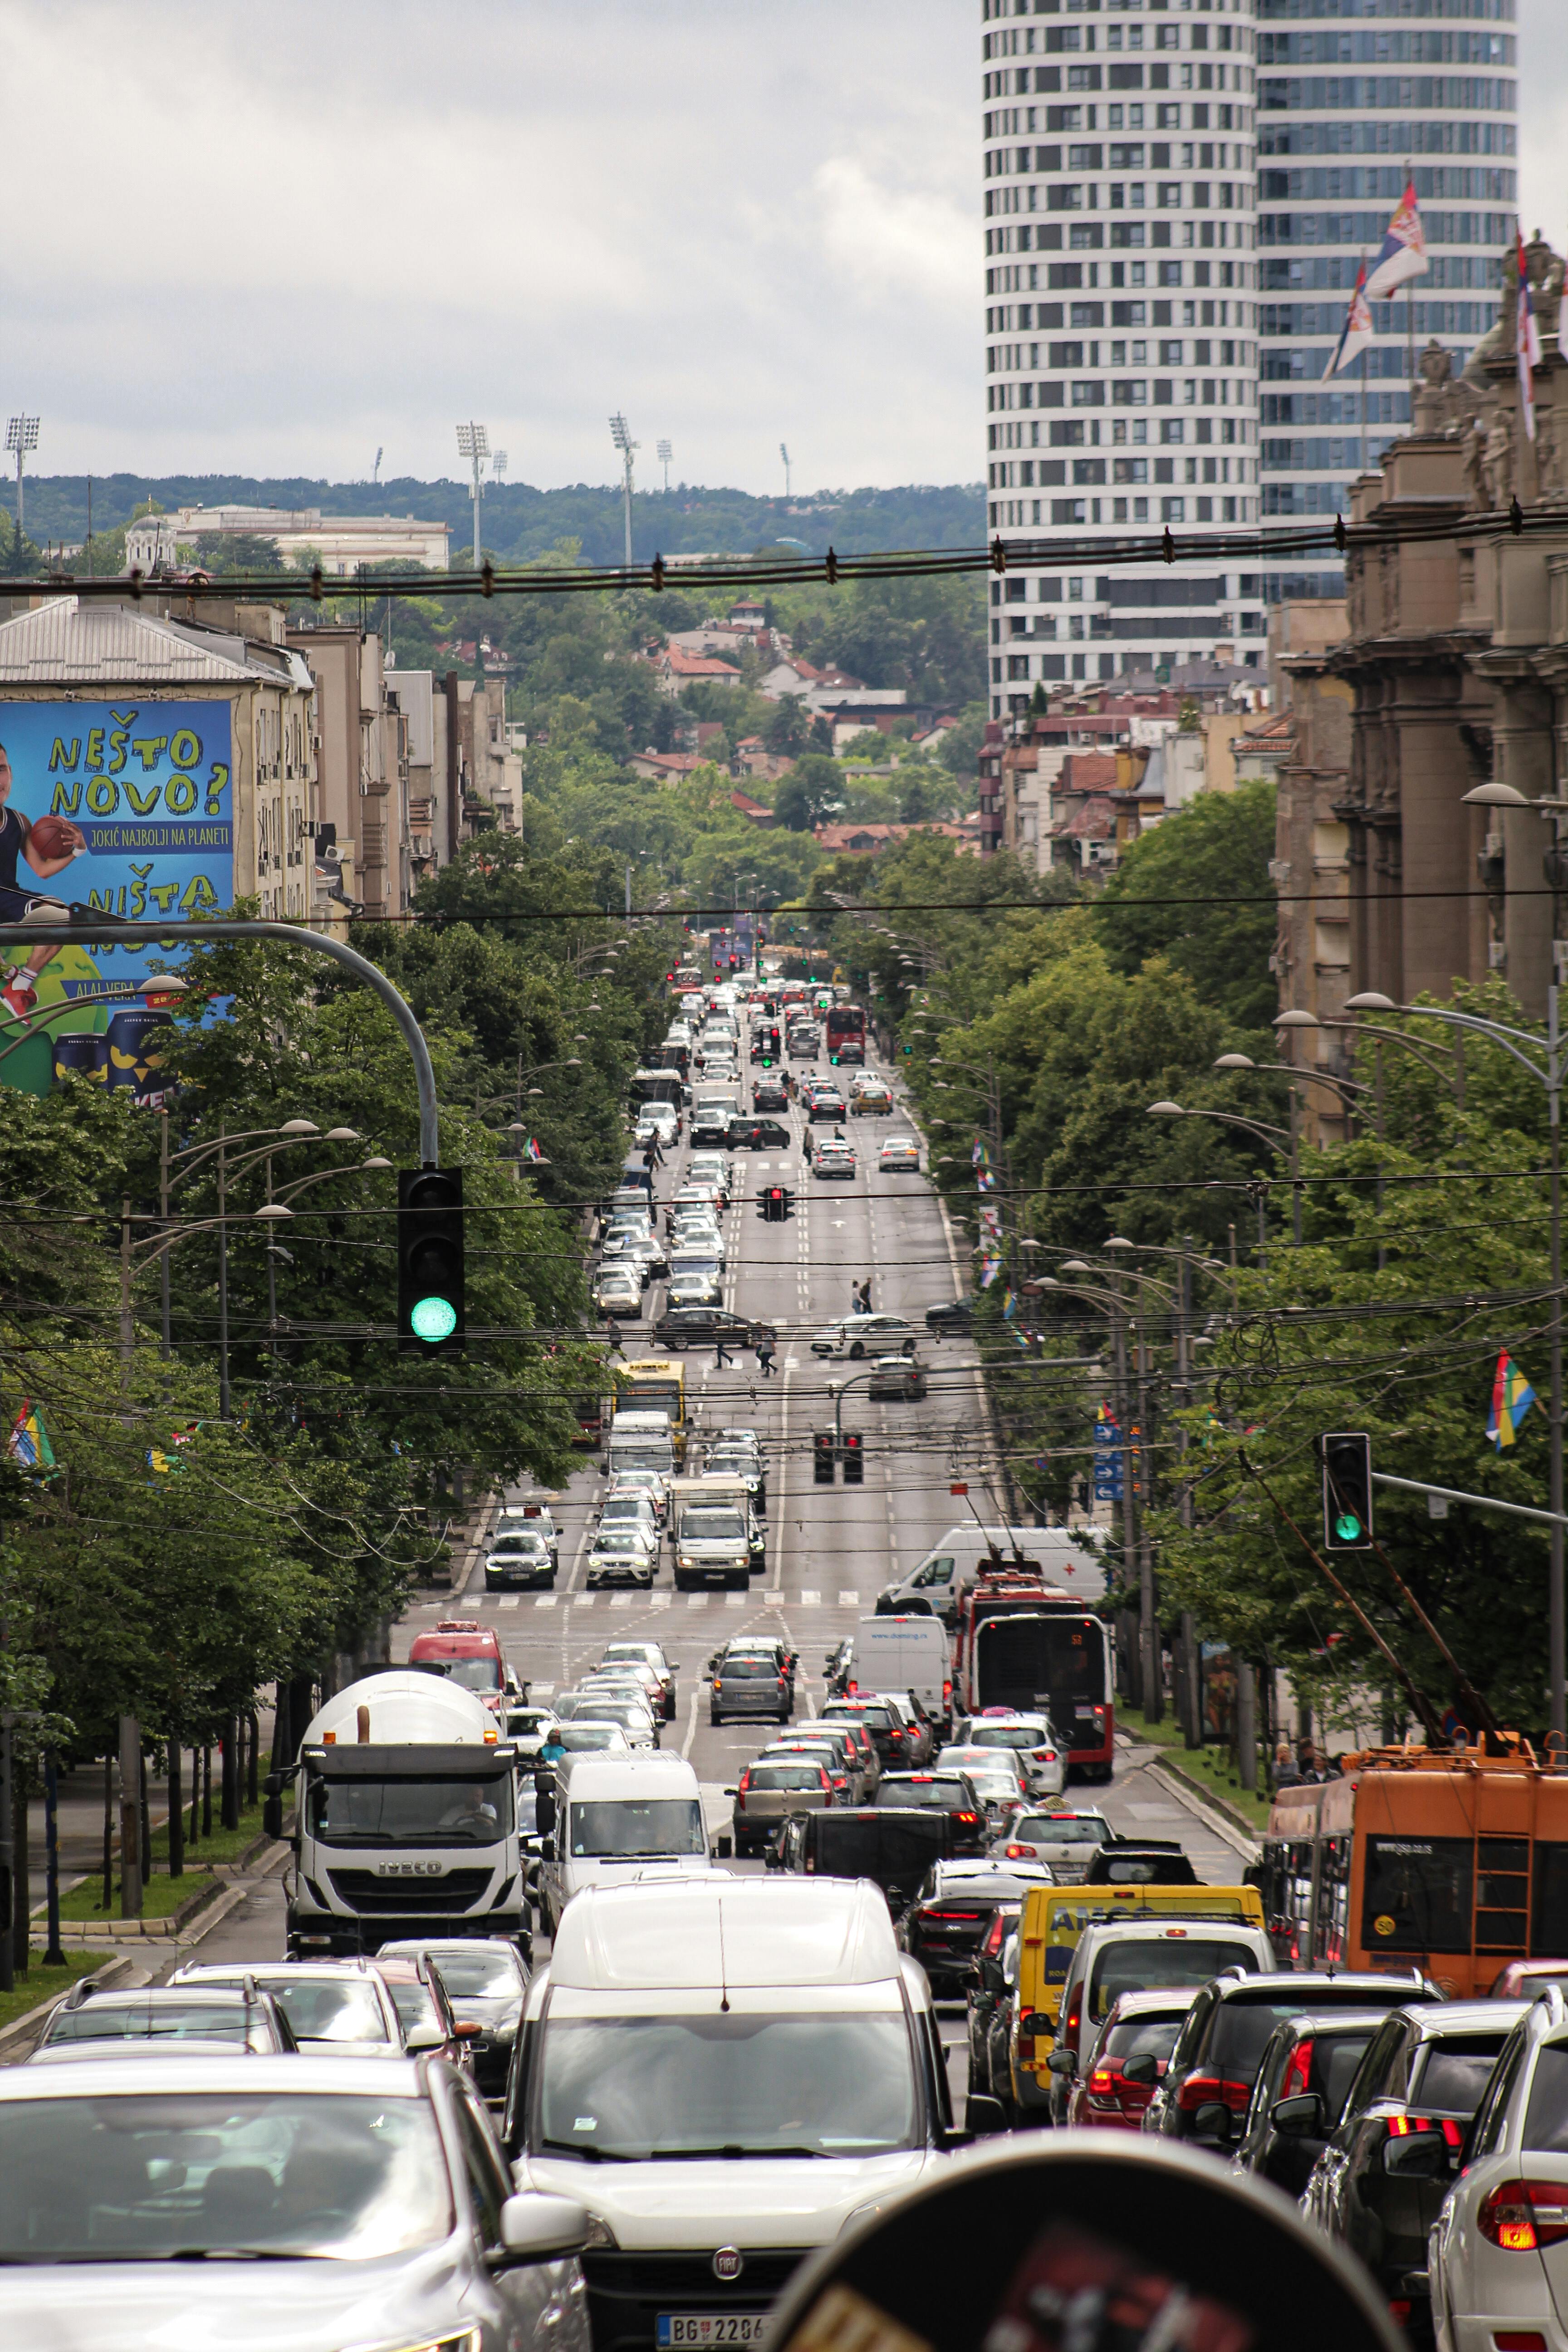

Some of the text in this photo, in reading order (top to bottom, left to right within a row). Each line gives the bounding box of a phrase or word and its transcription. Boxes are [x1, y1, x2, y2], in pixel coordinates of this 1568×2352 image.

[48, 710, 203, 775] NEŠTO
[49, 762, 229, 817] NOVO?
[92, 827, 229, 847] JOKIĆ NAJBOLJI NA PLANETI
[88, 863, 219, 919] NIŠTA
[379, 1861, 442, 1875] IVECO
[719, 2257, 738, 2272] FIAT
[674, 2319, 698, 2341] BG
